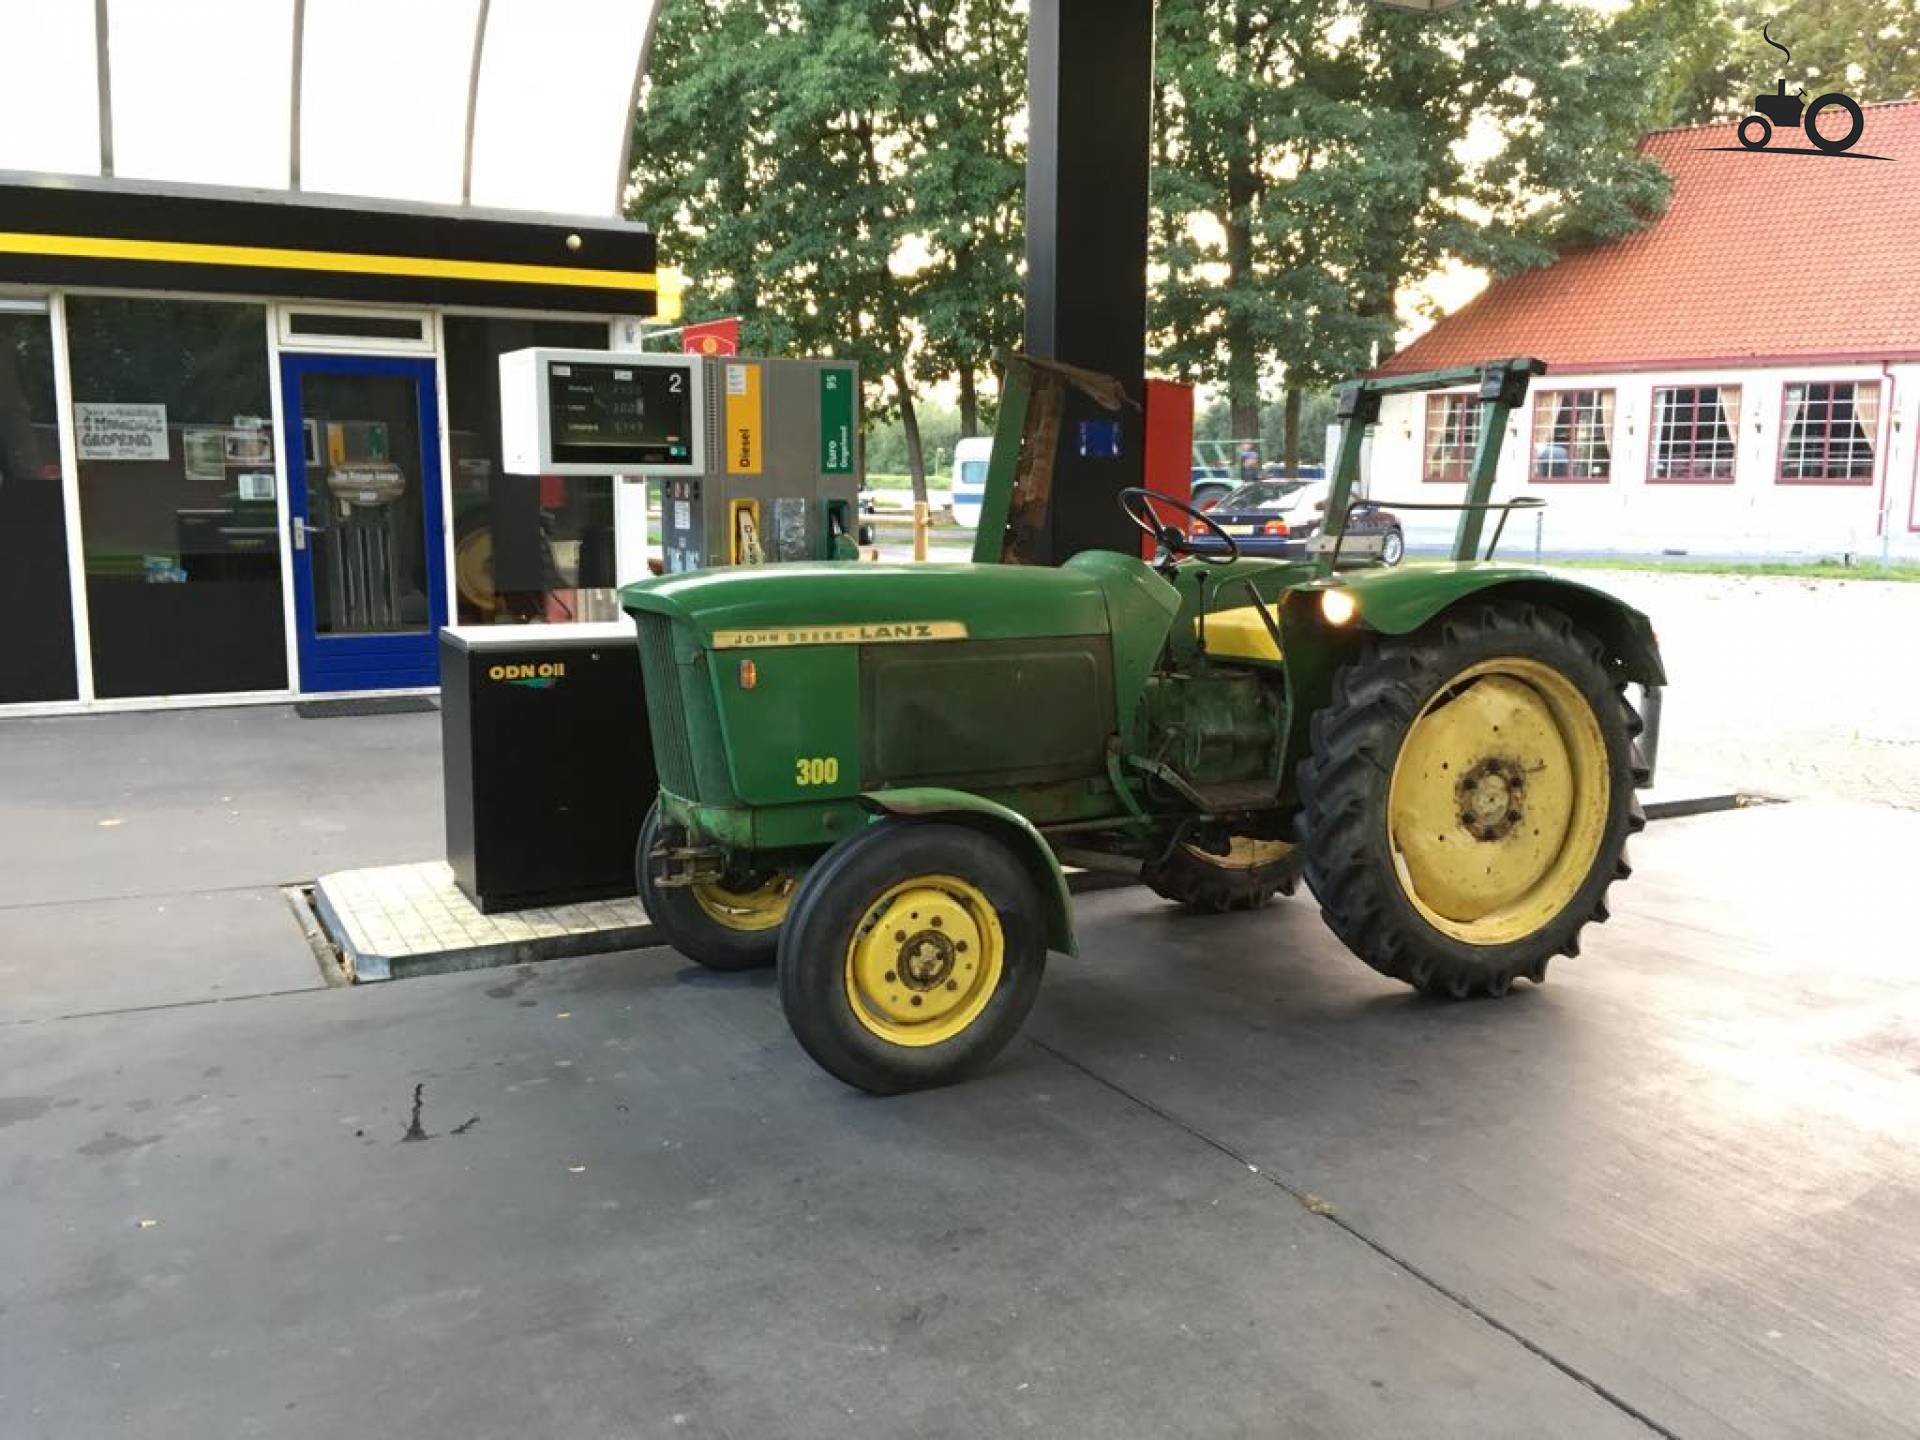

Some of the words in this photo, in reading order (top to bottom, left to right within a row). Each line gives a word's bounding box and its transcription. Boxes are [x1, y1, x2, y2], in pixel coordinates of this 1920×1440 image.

[668, 372, 682, 393] 2
[826, 374, 837, 389] 95
[738, 428, 750, 468] Diesel
[826, 440, 837, 468] Euro
[735, 633, 778, 645] JOHN
[860, 626, 932, 640] LANZ
[489, 665, 535, 680] ODN
[796, 757, 838, 785] 300
